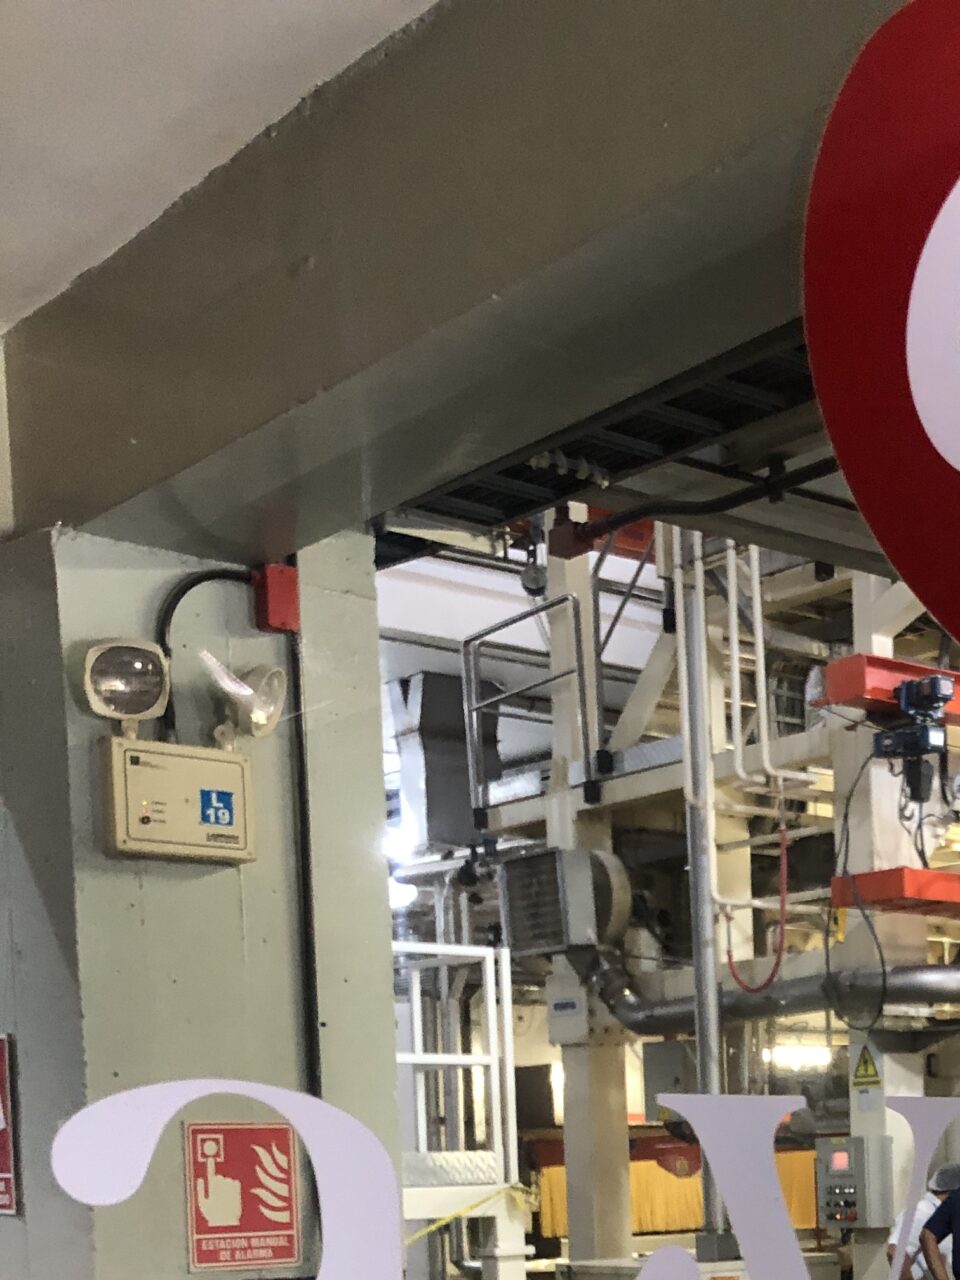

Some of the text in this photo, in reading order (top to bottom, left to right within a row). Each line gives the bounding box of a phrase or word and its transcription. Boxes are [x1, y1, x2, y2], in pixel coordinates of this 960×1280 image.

[211, 792, 224, 808] L
[206, 808, 231, 825] 19
[250, 1236, 289, 1248] MANUAL
[219, 1247, 273, 1261] DE ALARMA
